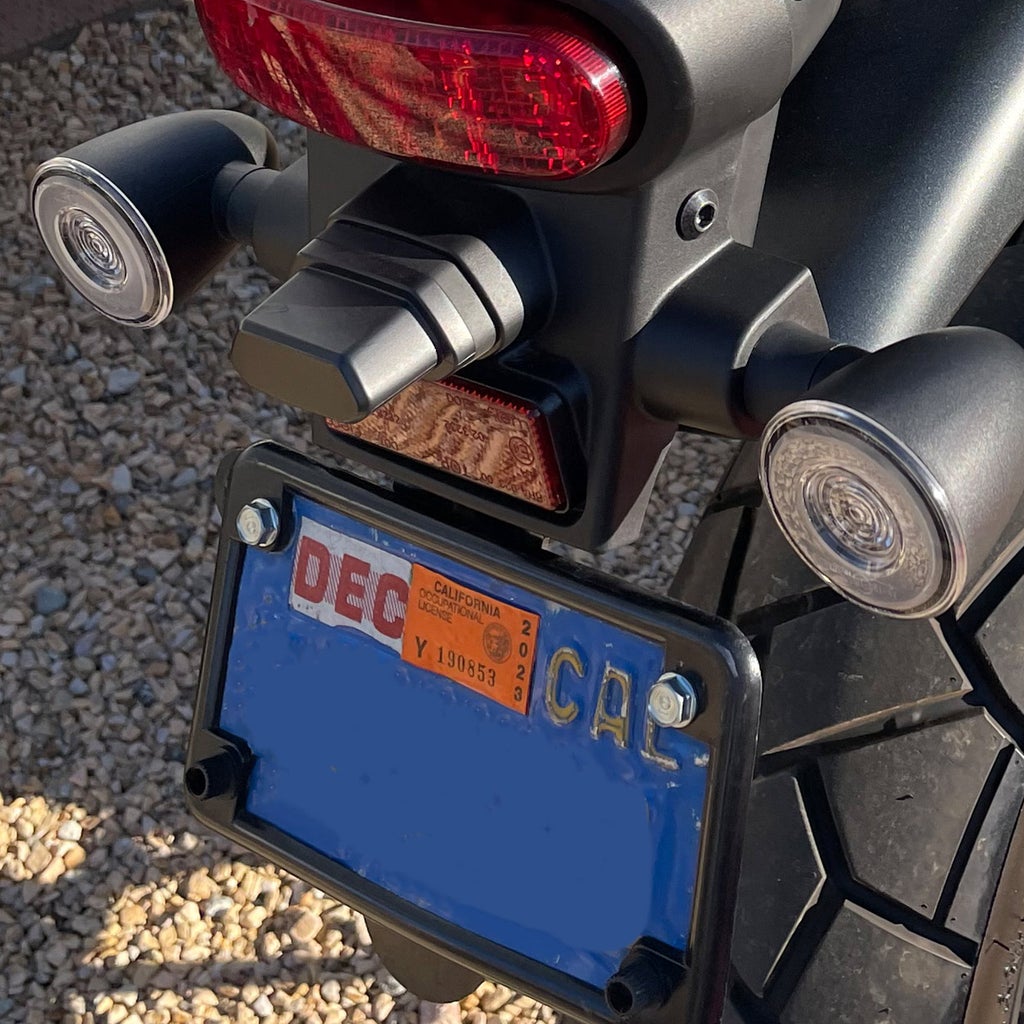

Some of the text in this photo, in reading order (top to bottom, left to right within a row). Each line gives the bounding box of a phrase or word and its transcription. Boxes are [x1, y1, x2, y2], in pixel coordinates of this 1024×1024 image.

[294, 535, 410, 639] DEC
[419, 588, 484, 625] OCCUPATIONAL
[434, 580, 501, 619] CALIFORNIA
[418, 599, 453, 624] LICENSE
[415, 636, 496, 687] Y 190853
